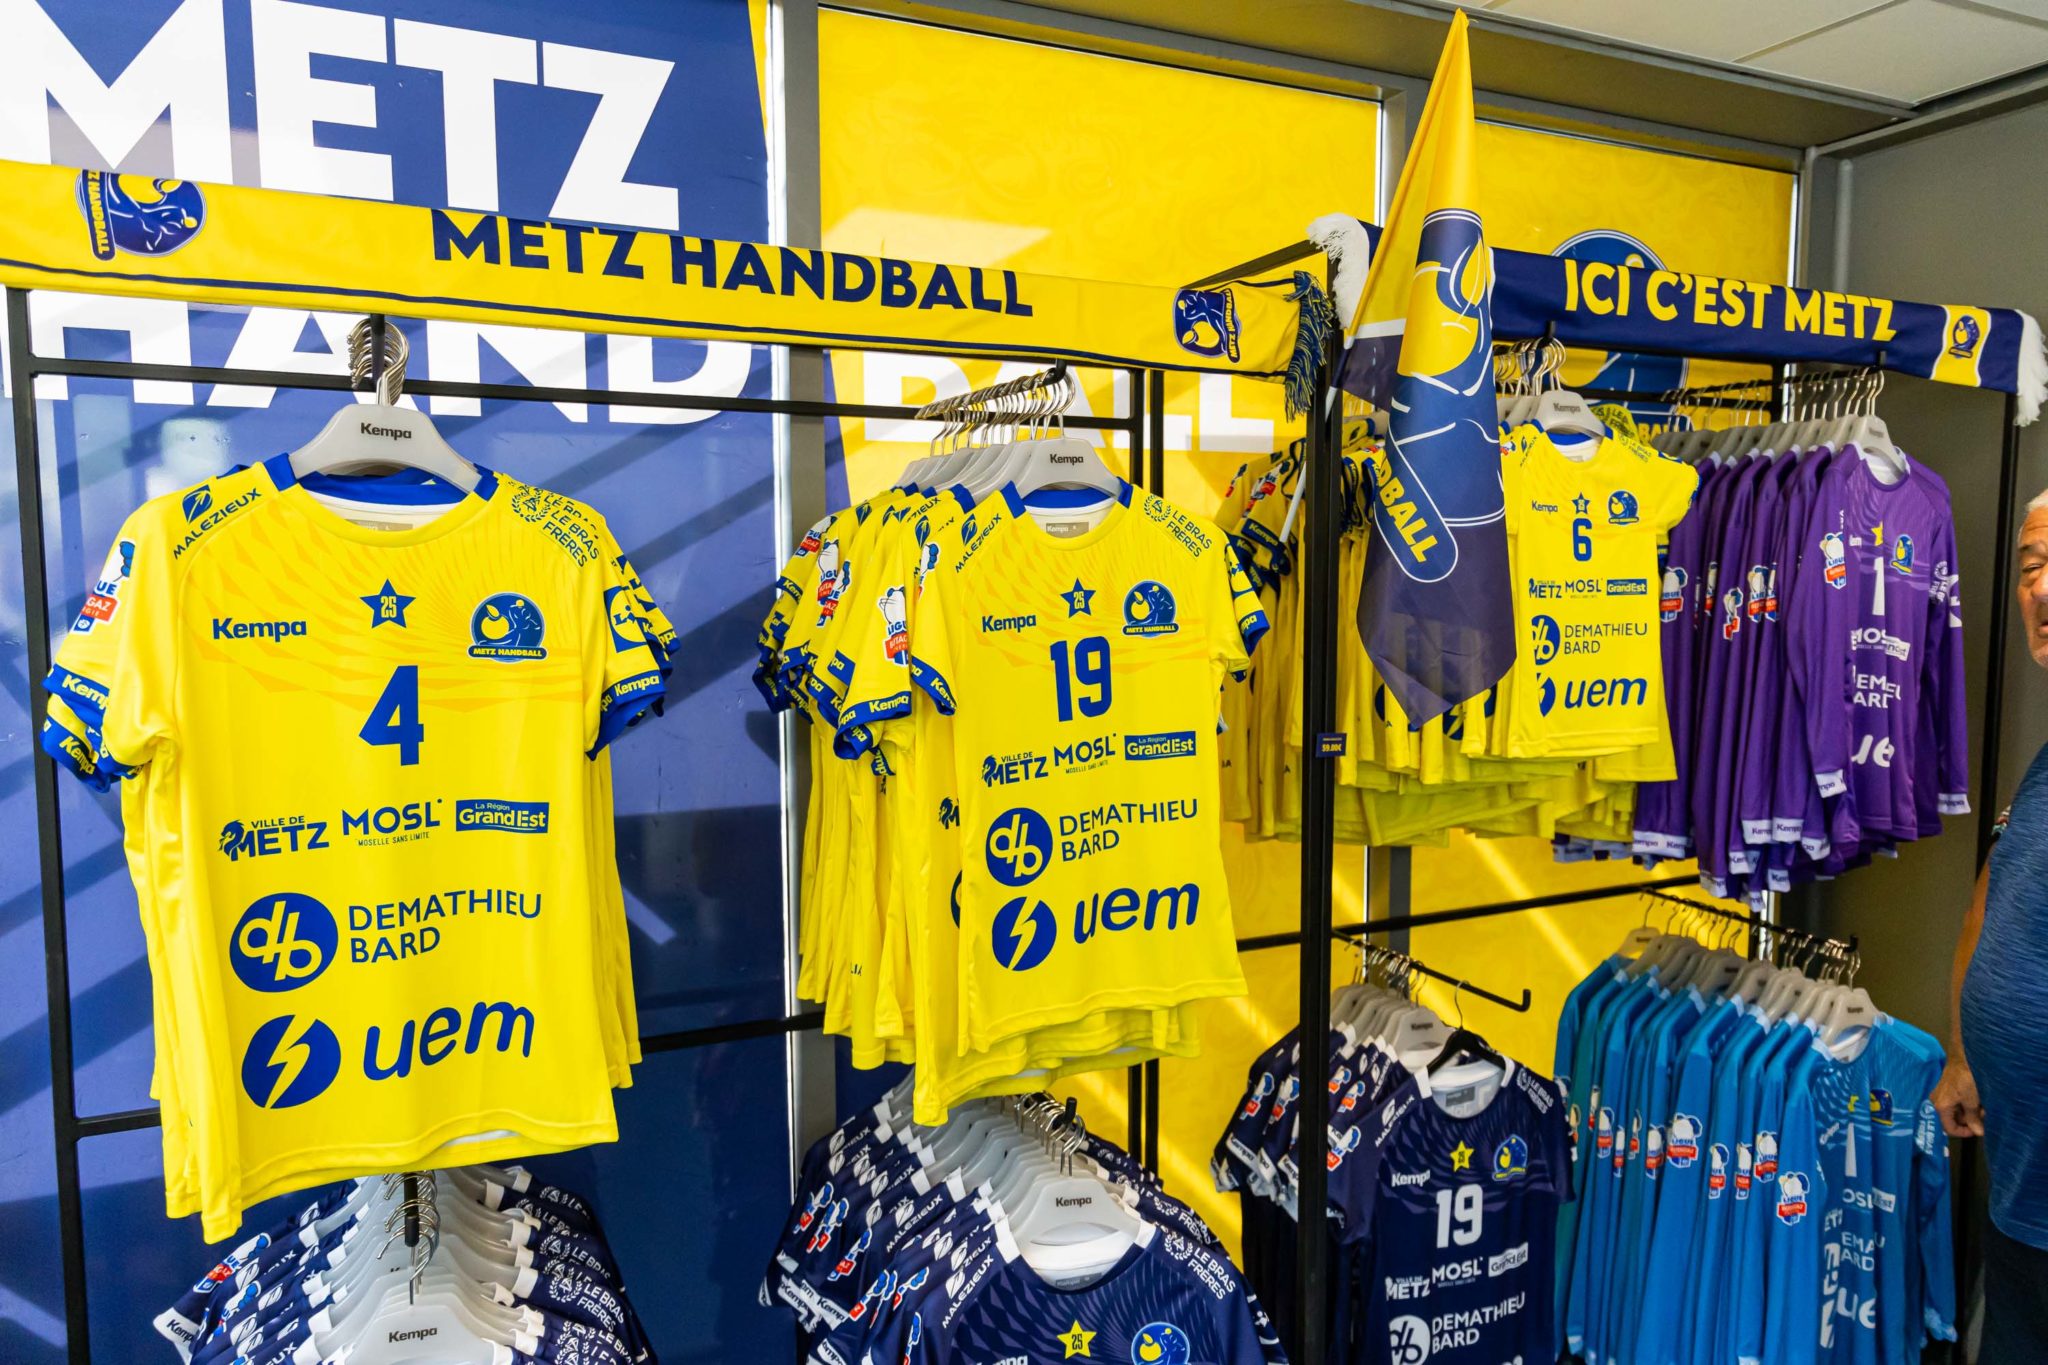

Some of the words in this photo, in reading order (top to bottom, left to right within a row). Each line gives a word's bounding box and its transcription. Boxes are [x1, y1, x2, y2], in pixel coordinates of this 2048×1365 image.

[433, 209, 645, 280] METZ
[670, 235, 1033, 317] HANDBALL
[1564, 259, 1630, 316] ICI
[1784, 286, 1897, 341] METZ
[1553, 403, 1581, 414] Kempa
[360, 422, 412, 441] Kempa
[1049, 453, 1084, 465] Kempa
[1531, 500, 1558, 514] Kempa
[173, 487, 262, 560] MALEZIEUX
[551, 510, 569, 527] LE
[568, 523, 600, 560] BRAS
[1183, 519, 1213, 549] BRAS
[954, 513, 1002, 573] MALEZIEUX
[1572, 518, 1593, 563] 6
[1530, 584, 1562, 598] METZ
[1872, 556, 1885, 616] 1
[380, 596, 397, 618] 25
[1073, 591, 1085, 609] 25
[212, 617, 307, 643] Kempa
[887, 621, 907, 635] LIGU
[982, 615, 1037, 633] Kempa
[1144, 625, 1176, 633] HANDBALL
[1565, 622, 1648, 638] DEMATHIEU
[473, 647, 496, 656] METZ
[498, 647, 543, 657] HANDBALL
[1564, 640, 1600, 654] BARD
[614, 674, 660, 697] Kempa
[1050, 635, 1112, 722] 19
[869, 695, 909, 713] Kempa
[1564, 677, 1648, 709] uem
[358, 665, 424, 767] 4
[1001, 754, 1022, 763] VILLE
[1023, 751, 1033, 759] DE
[985, 756, 1049, 786] METZ
[475, 802, 485, 810] La
[486, 803, 511, 812] Région
[1059, 799, 1198, 836] DEMATHIEU
[251, 818, 285, 829] VILLE
[288, 815, 305, 825] DE
[232, 822, 330, 861] METZ
[357, 838, 390, 847] MOSELLE
[392, 835, 408, 844] SANS
[409, 831, 430, 842] LIMITE
[1061, 829, 1120, 862] BARD
[348, 888, 542, 931] DEMATHIEU
[1073, 883, 1200, 944] uem
[350, 926, 441, 963] BARD
[362, 1001, 535, 1081] uem
[1845, 1122, 1857, 1178] 1
[1055, 1196, 1092, 1208] Kempa
[1436, 1183, 1484, 1249] 19
[1193, 1247, 1208, 1265] LE
[1206, 1259, 1236, 1293] BRAS
[942, 1254, 994, 1329] MALEZIEUX
[1385, 1278, 1430, 1301] METZ
[584, 1283, 601, 1297] LE
[599, 1292, 624, 1323] BRAS
[816, 1297, 845, 1321] Kemp
[1432, 1291, 1525, 1335] DEMATHIEU
[167, 1319, 194, 1342] Kemp
[388, 1327, 438, 1345] Kempa
[1071, 1334, 1083, 1350] 25
[1432, 1328, 1480, 1355] BARD
